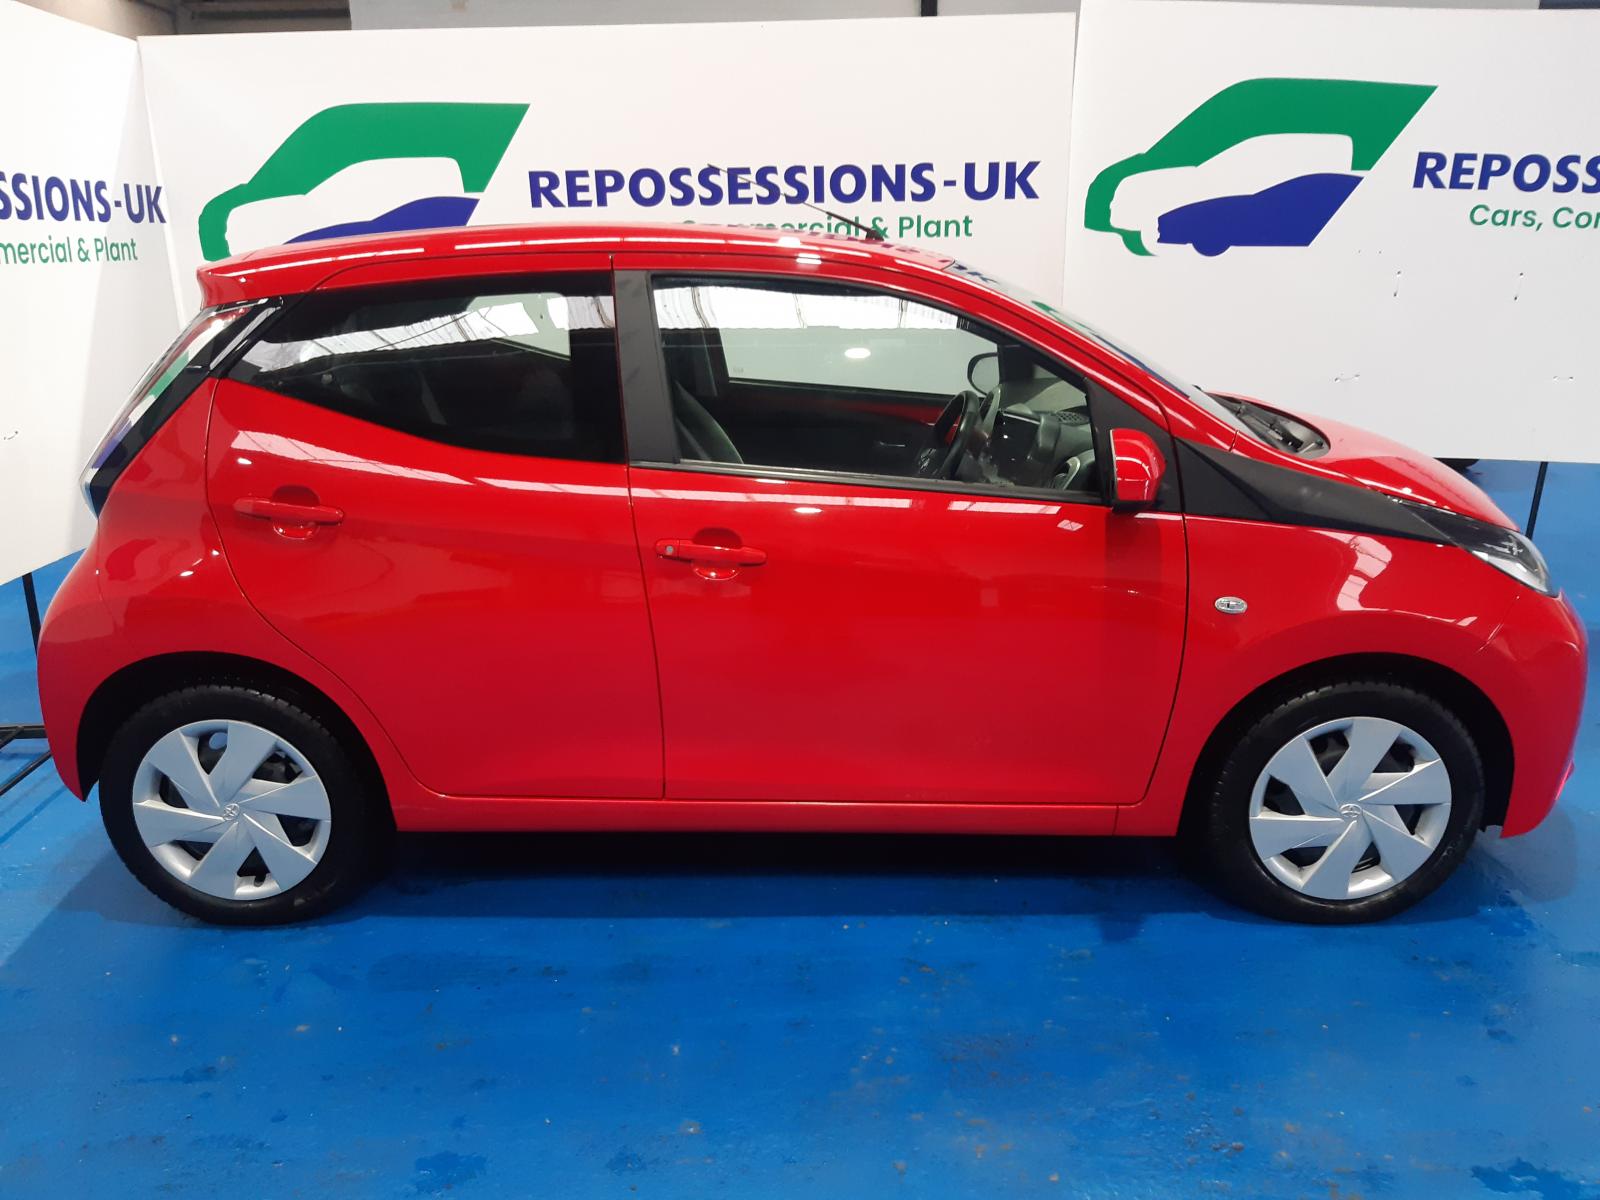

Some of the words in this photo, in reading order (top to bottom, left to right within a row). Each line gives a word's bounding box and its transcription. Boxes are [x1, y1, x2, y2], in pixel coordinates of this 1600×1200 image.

[528, 160, 1040, 208] REPOSSESSIONS-UK
[898, 214, 973, 238] Plant
[1468, 204, 1543, 231] Cars,
[1552, 206, 1600, 229] Co
[77, 237, 91, 262] &
[94, 236, 138, 261] Plant
